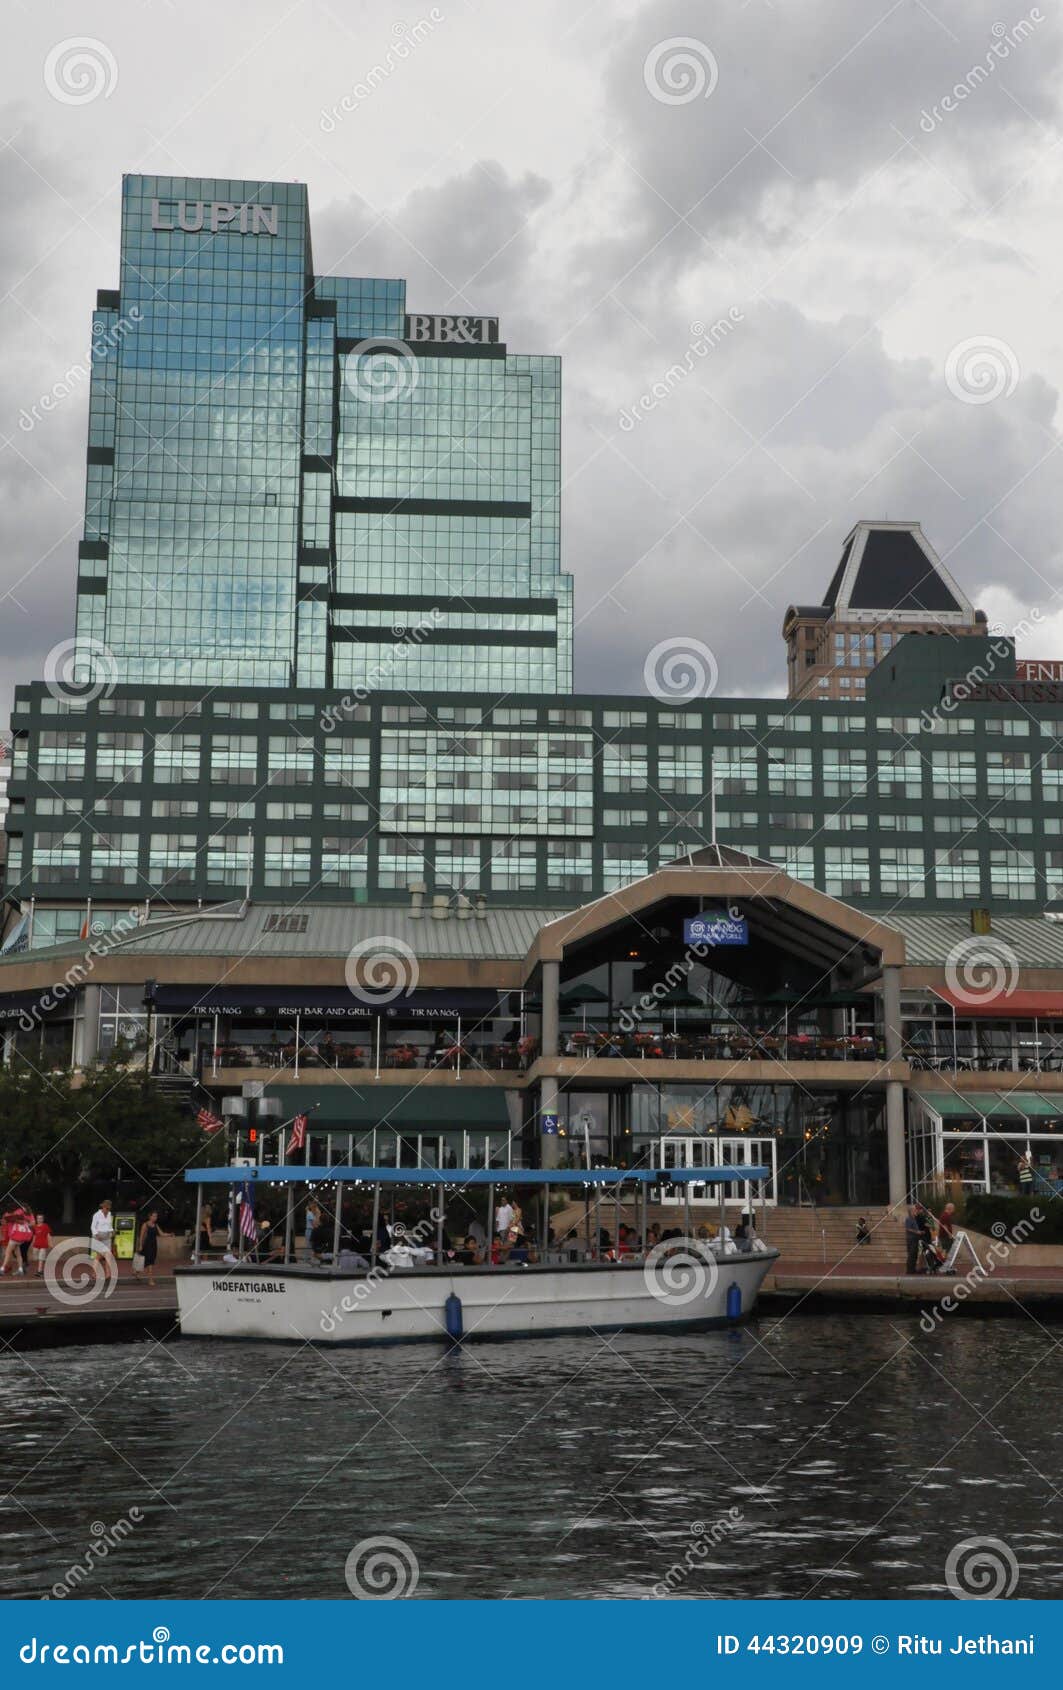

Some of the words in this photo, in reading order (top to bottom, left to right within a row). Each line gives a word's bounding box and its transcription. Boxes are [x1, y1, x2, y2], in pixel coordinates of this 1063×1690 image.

[152, 198, 278, 236] LUPIN
[405, 314, 499, 344] BB&T
[208, 1006, 221, 1015] NA
[278, 1007, 301, 1015] IRISH
[304, 1007, 323, 1015] BAR
[325, 1008, 345, 1016] AND
[347, 1008, 373, 1016] GRILL
[426, 1008, 439, 1017] NA
[212, 1281, 286, 1293] INDEFATIGABLE
